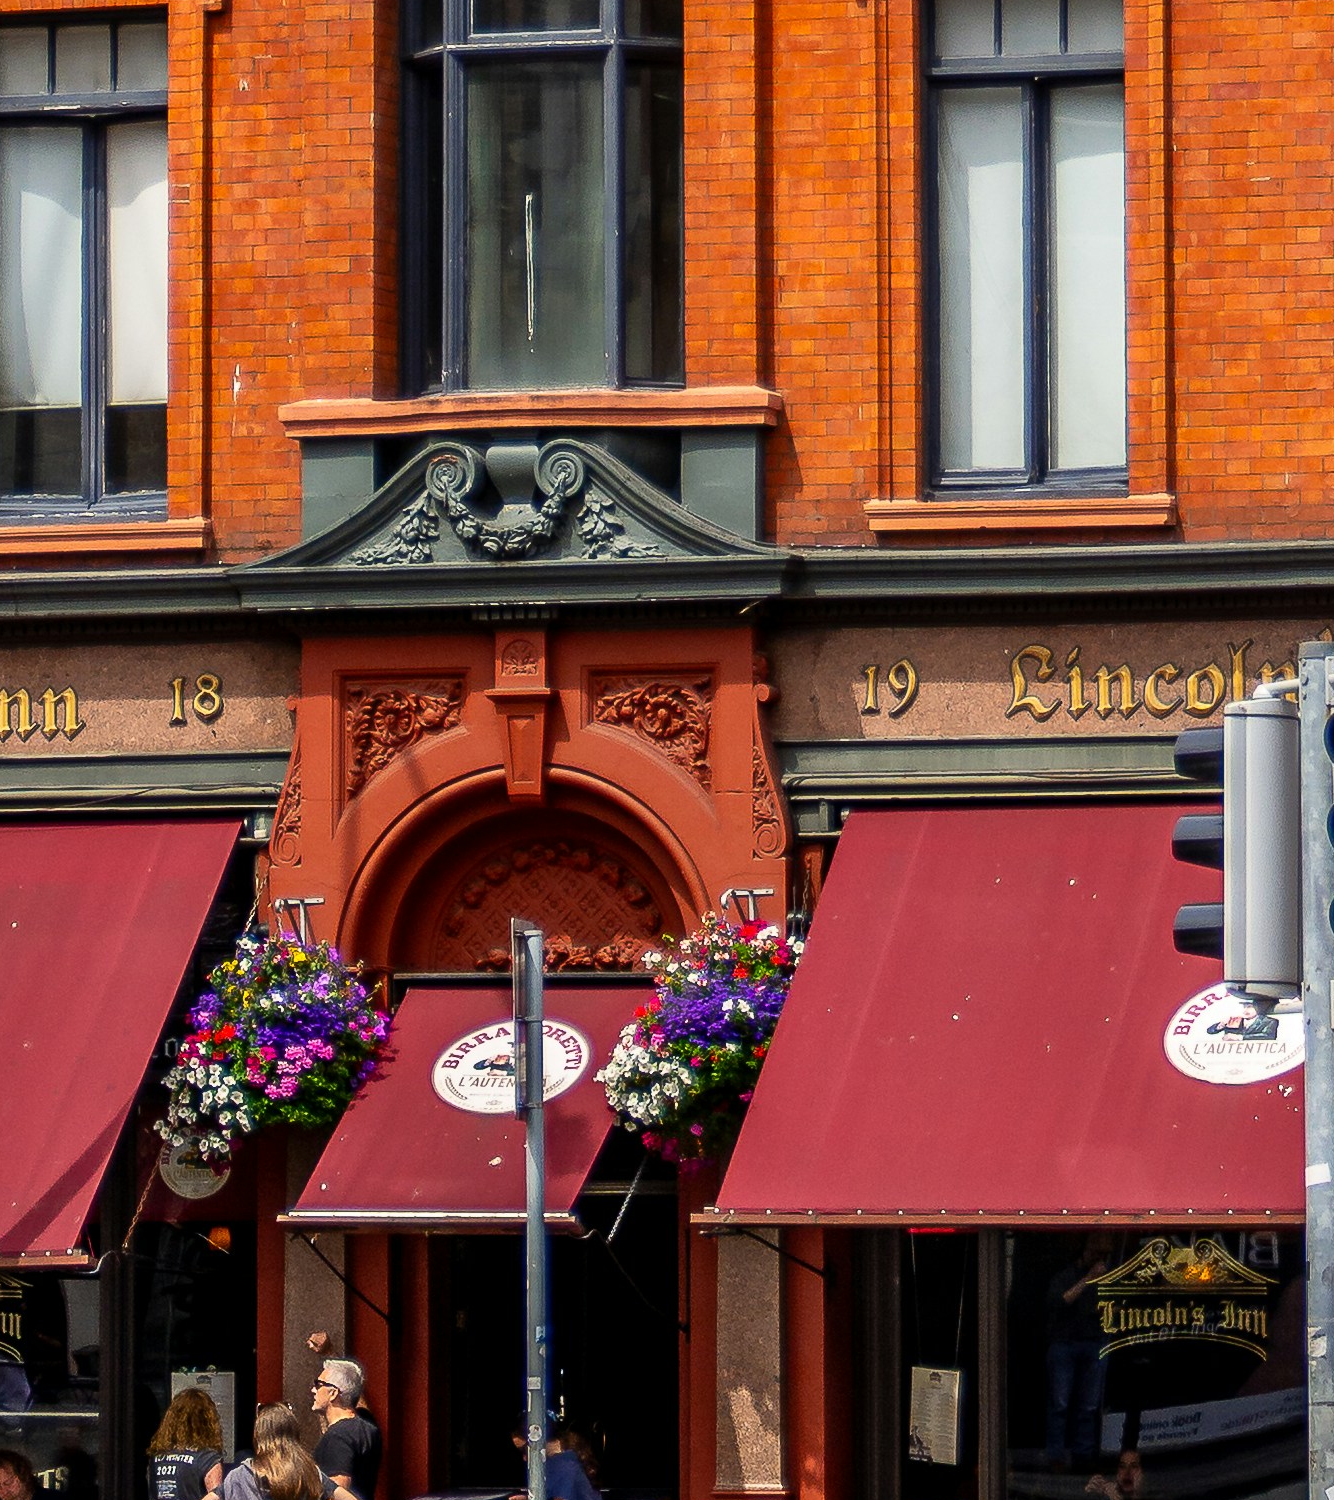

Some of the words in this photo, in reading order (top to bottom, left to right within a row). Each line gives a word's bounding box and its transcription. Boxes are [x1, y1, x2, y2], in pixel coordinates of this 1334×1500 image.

[169, 673, 223, 728] 18
[861, 658, 920, 719] 19
[1173, 989, 1233, 1036] BIRR
[441, 1026, 511, 1070] BIRRA
[1193, 1041, 1287, 1055] L'AUTENTICA
[1097, 1300, 1206, 1335] Lincoln's
[1219, 1299, 1268, 1340] Inn
